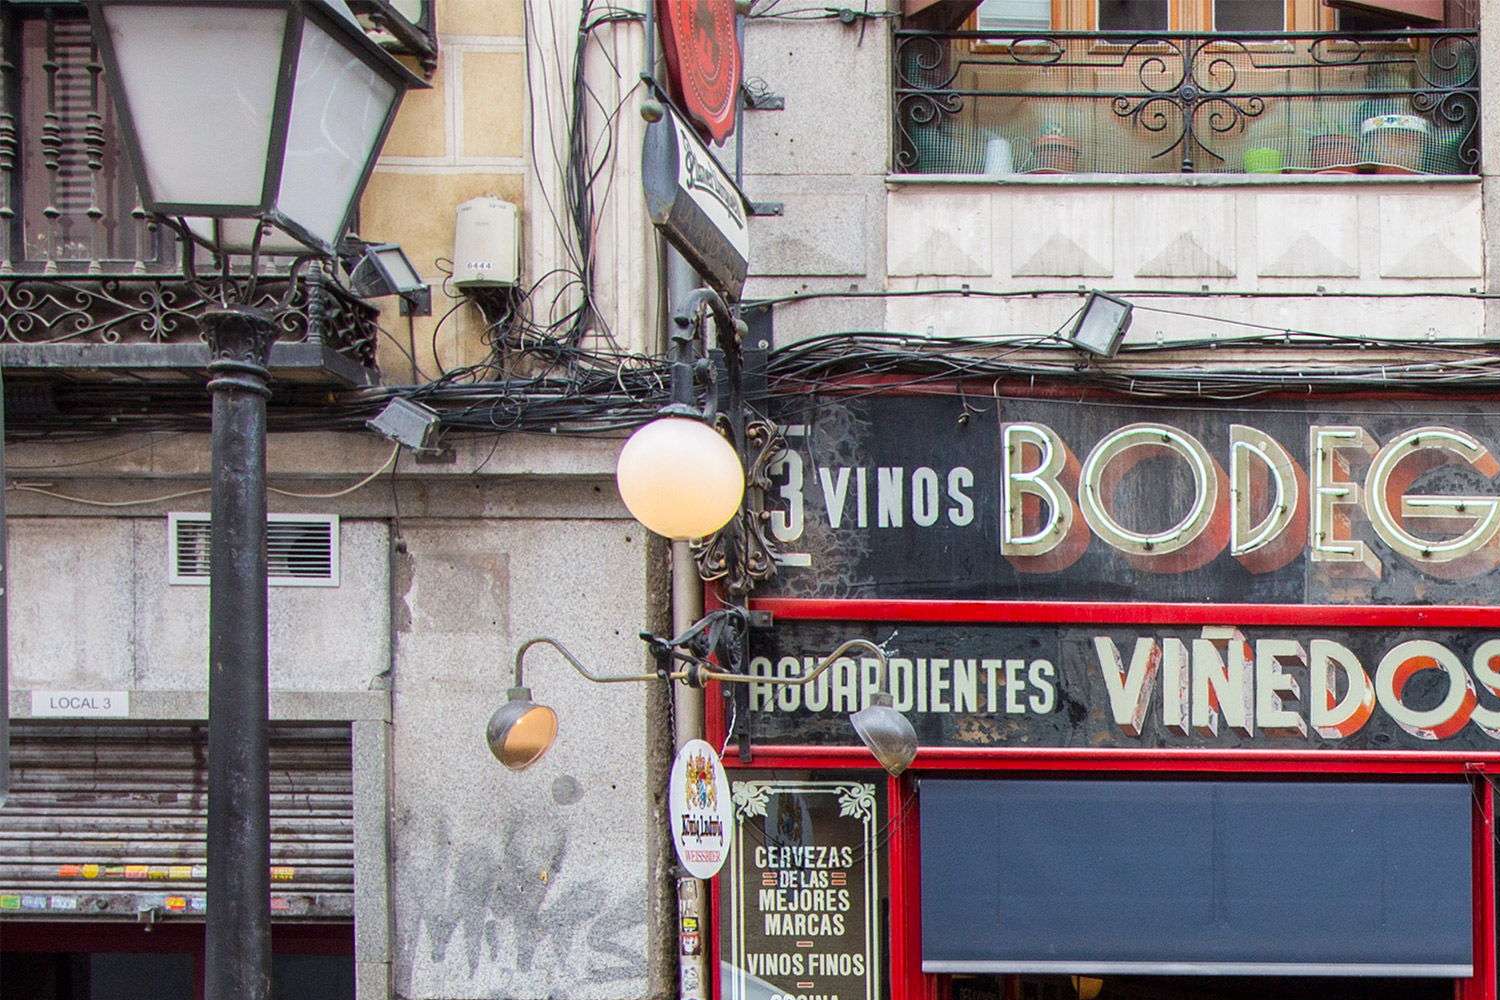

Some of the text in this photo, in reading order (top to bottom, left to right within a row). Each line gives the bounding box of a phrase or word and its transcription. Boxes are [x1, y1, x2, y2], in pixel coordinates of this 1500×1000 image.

[819, 466, 974, 528] VINOS
[750, 656, 1055, 714] AGUARDIENTES
[50, 697, 111, 709] LOCAL 3
[685, 850, 721, 862] WEISSBIER
[755, 846, 853, 868] CERVEZAS
[780, 870, 828, 888] DE LAS
[759, 889, 851, 911] MEJORES
[765, 913, 845, 936] MARCAS
[747, 953, 865, 976] VINOS FINOS
